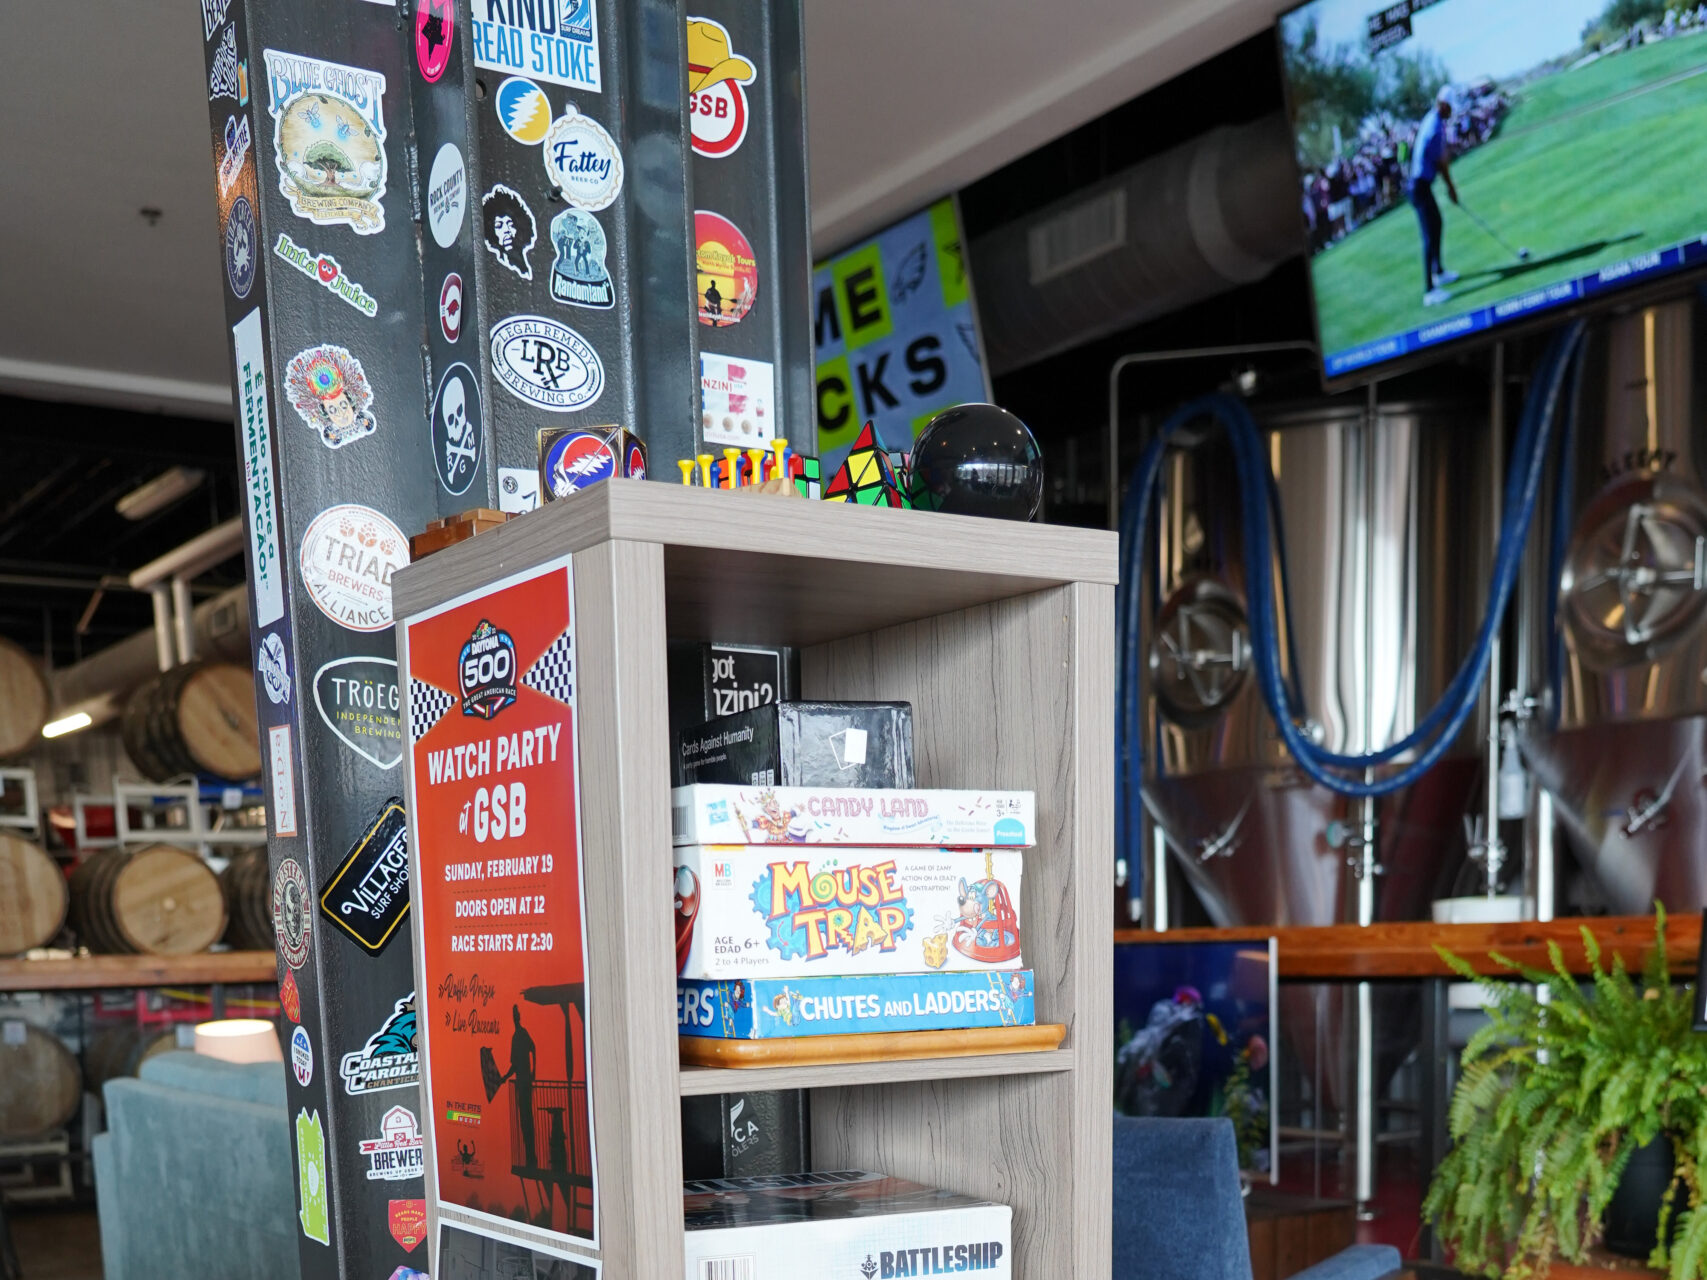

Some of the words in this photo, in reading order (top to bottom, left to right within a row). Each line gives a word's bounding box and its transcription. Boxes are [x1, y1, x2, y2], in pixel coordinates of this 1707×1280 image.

[530, 32, 596, 85] STOKE
[268, 53, 321, 114] BLUE
[322, 66, 383, 134] GHOST
[689, 93, 728, 119] GSB
[553, 140, 612, 181] Fattey
[430, 184, 442, 207] ROCK
[443, 167, 463, 196] COUNTY
[301, 197, 337, 209] BREWING
[338, 198, 375, 211] COMPANY
[277, 236, 317, 275] Inta
[330, 273, 375, 313] Juice
[737, 255, 756, 267] Tours
[499, 322, 541, 343] LEGAL
[544, 325, 597, 366] REMEDY
[504, 370, 565, 404] BREWING
[255, 396, 268, 459] tudo
[262, 466, 273, 533] sobre
[325, 534, 398, 587] TRIAD
[328, 568, 384, 601] BREWERS
[314, 584, 390, 625] ALLIANCE
[471, 635, 499, 655] DAYTONA
[464, 649, 510, 688] 500
[463, 700, 471, 710] THE
[471, 692, 483, 704] GREAT
[484, 687, 505, 697] AMERICAN
[505, 688, 516, 696] RACE
[354, 725, 401, 740] BREWING
[682, 742, 699, 757] Cards
[700, 736, 722, 754] Against
[723, 725, 754, 746] Humanity
[427, 739, 490, 786] WATCH
[498, 722, 562, 773] PARTY
[459, 800, 472, 836] at
[473, 781, 527, 844] GSB
[807, 796, 873, 818] CANDY
[880, 797, 929, 818] LAND
[445, 861, 485, 882] SUNDAY,
[487, 855, 540, 879] FEBRUARY
[541, 854, 553, 873] 19
[714, 863, 732, 877] MB
[371, 889, 392, 920] SURF
[766, 859, 904, 920] MOUSE
[456, 899, 487, 918] DOORS
[490, 897, 517, 916] OPEN
[519, 896, 532, 914] AT
[534, 896, 545, 914] 12
[452, 935, 475, 952] RACE
[478, 934, 513, 952] STARTS
[516, 933, 529, 951] AT
[531, 932, 553, 951] 2:30
[714, 936, 734, 945] AGE
[714, 945, 741, 954] EDAD
[744, 938, 760, 950] 6+
[792, 906, 906, 962] TRAP
[715, 957, 720, 966] 2
[721, 957, 732, 966] to
[733, 957, 739, 966] 4
[741, 956, 769, 966] Players
[800, 993, 881, 1021] CHUTES
[884, 999, 912, 1017] AND
[913, 988, 1000, 1017] LADDERS
[453, 1011, 467, 1033] Live
[349, 1064, 420, 1092] CAROLI
[454, 1102, 466, 1111] THE
[467, 1103, 481, 1112] PITS
[392, 1223, 428, 1235] HAPPY
[880, 1241, 1003, 1280] BATTLESHIP
